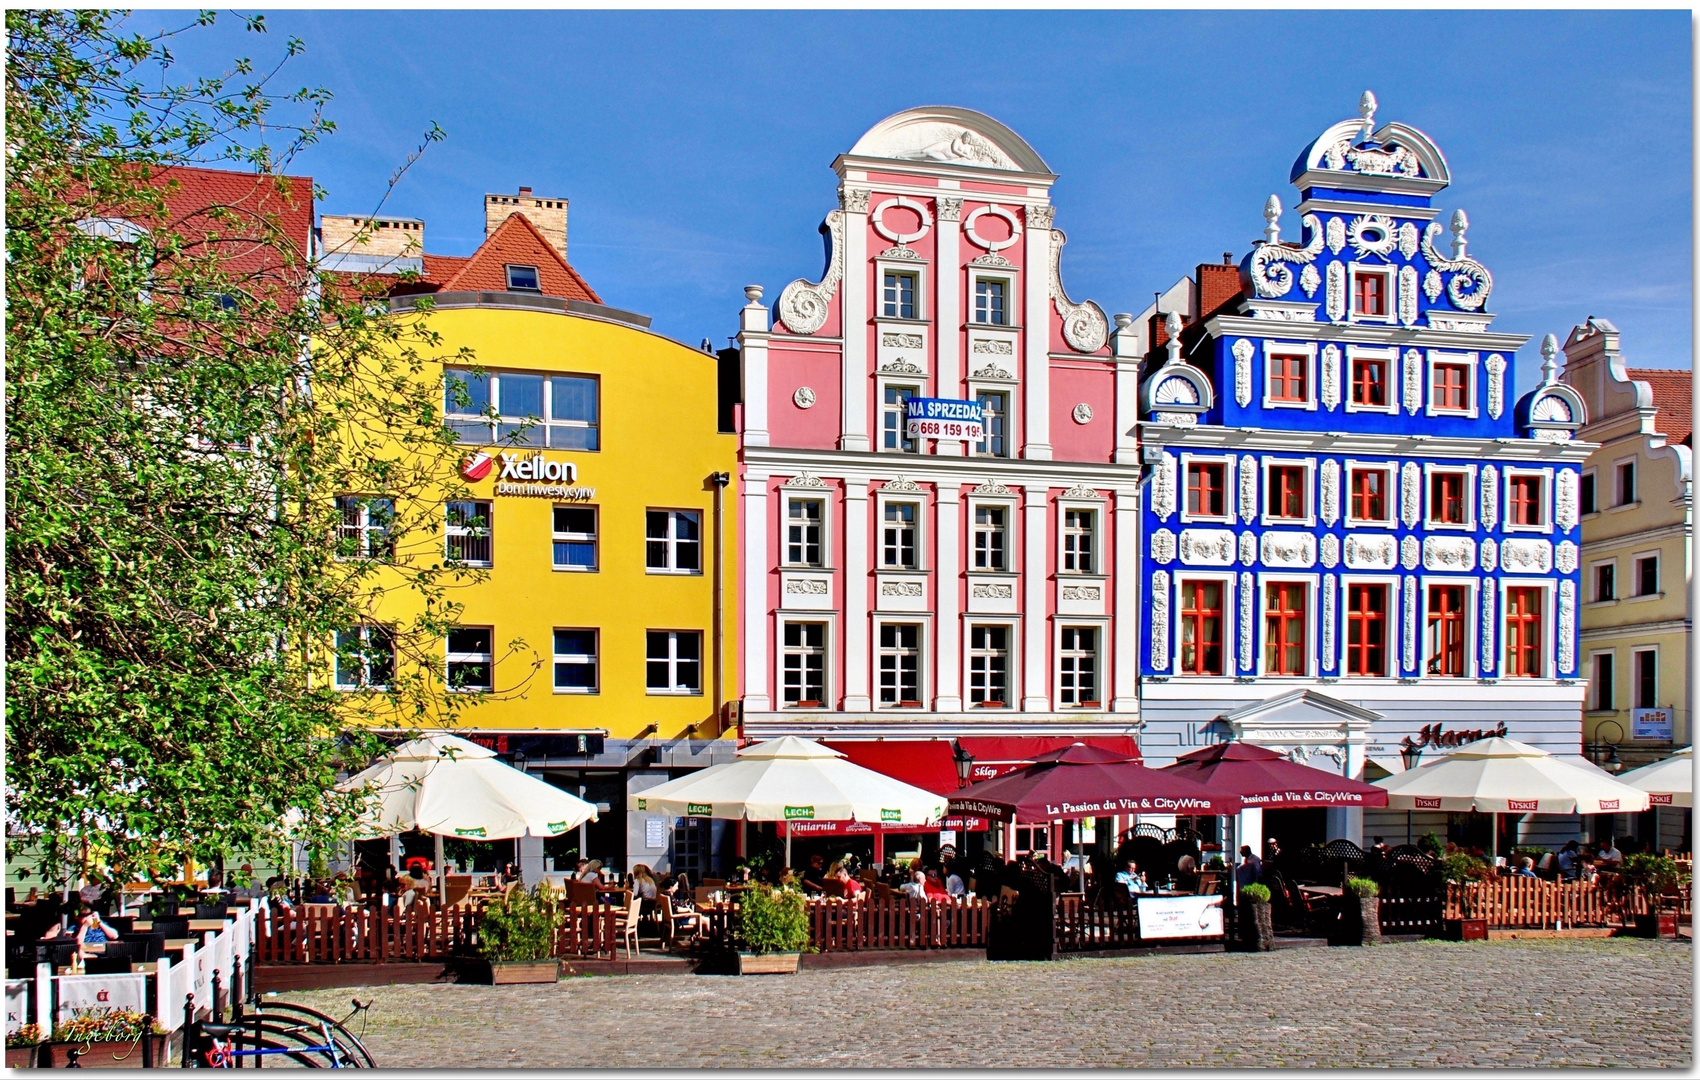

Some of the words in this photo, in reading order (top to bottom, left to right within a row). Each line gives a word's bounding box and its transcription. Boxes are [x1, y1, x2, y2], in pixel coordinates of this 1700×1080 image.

[908, 402, 925, 417] NA
[927, 402, 982, 421] SPRZEDAŻ
[920, 421, 940, 435] 668
[943, 423, 962, 437] 159
[500, 452, 578, 482] Xelion
[498, 482, 526, 494] Dom
[527, 483, 596, 499] Inwestycyjny
[974, 766, 998, 779] Sklep
[1271, 793, 1283, 802] du
[1285, 792, 1301, 801] Vin
[1303, 792, 1312, 801] &
[1314, 791, 1362, 803] CityWine
[1416, 799, 1439, 807] TYSKIE
[1650, 795, 1671, 803] TYSKIE
[688, 804, 708, 814] LECH
[978, 802, 1002, 815] CityWine
[1046, 804, 1060, 815] La
[1063, 801, 1100, 814] Passion
[1103, 799, 1117, 810] du
[1118, 798, 1138, 809] Vin
[1140, 798, 1151, 809] &
[1154, 797, 1211, 811] CityWine
[1510, 801, 1537, 810] TYSKIE
[1600, 801, 1620, 809] TYSKIE
[785, 808, 809, 816] LECH
[881, 810, 898, 818] LECH
[790, 821, 837, 832] Winiarnia
[926, 817, 979, 831] Restaurcja
